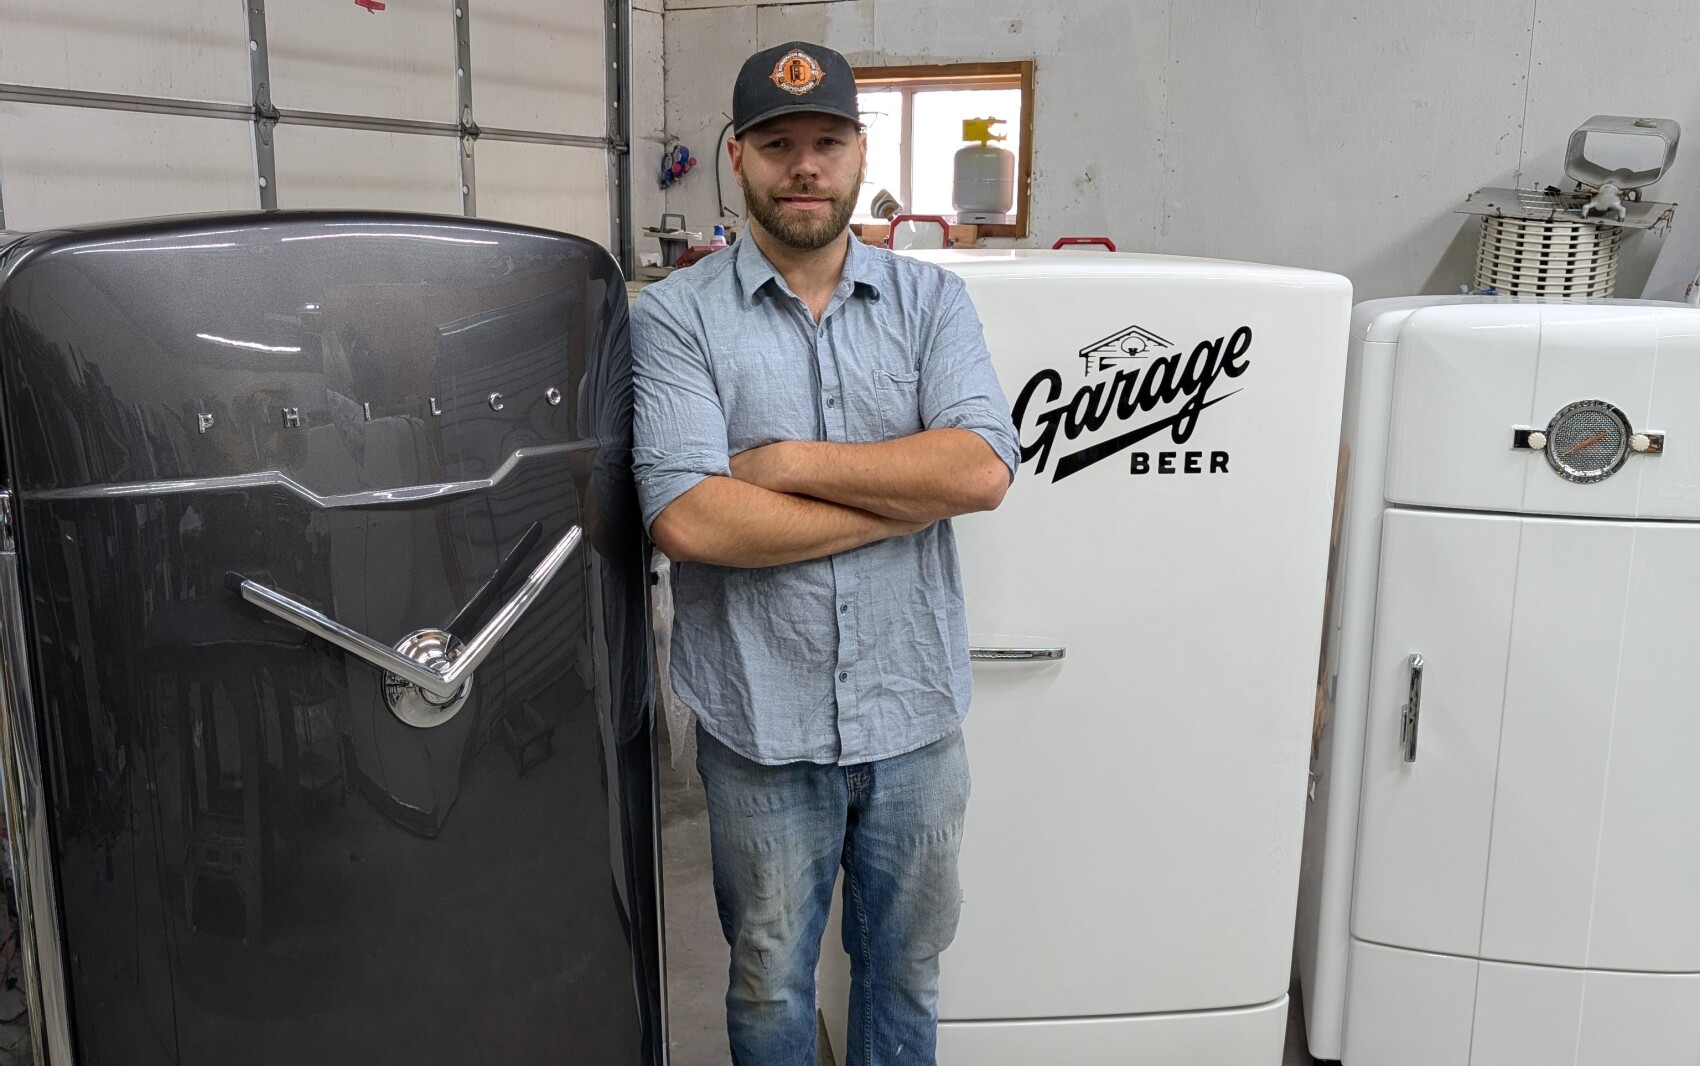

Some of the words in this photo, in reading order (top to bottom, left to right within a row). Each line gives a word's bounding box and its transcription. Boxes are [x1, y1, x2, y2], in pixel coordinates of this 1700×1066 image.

[198, 386, 561, 434] PHILCO
[1011, 326, 1252, 475] Garage
[1130, 451, 1230, 474] BEER
